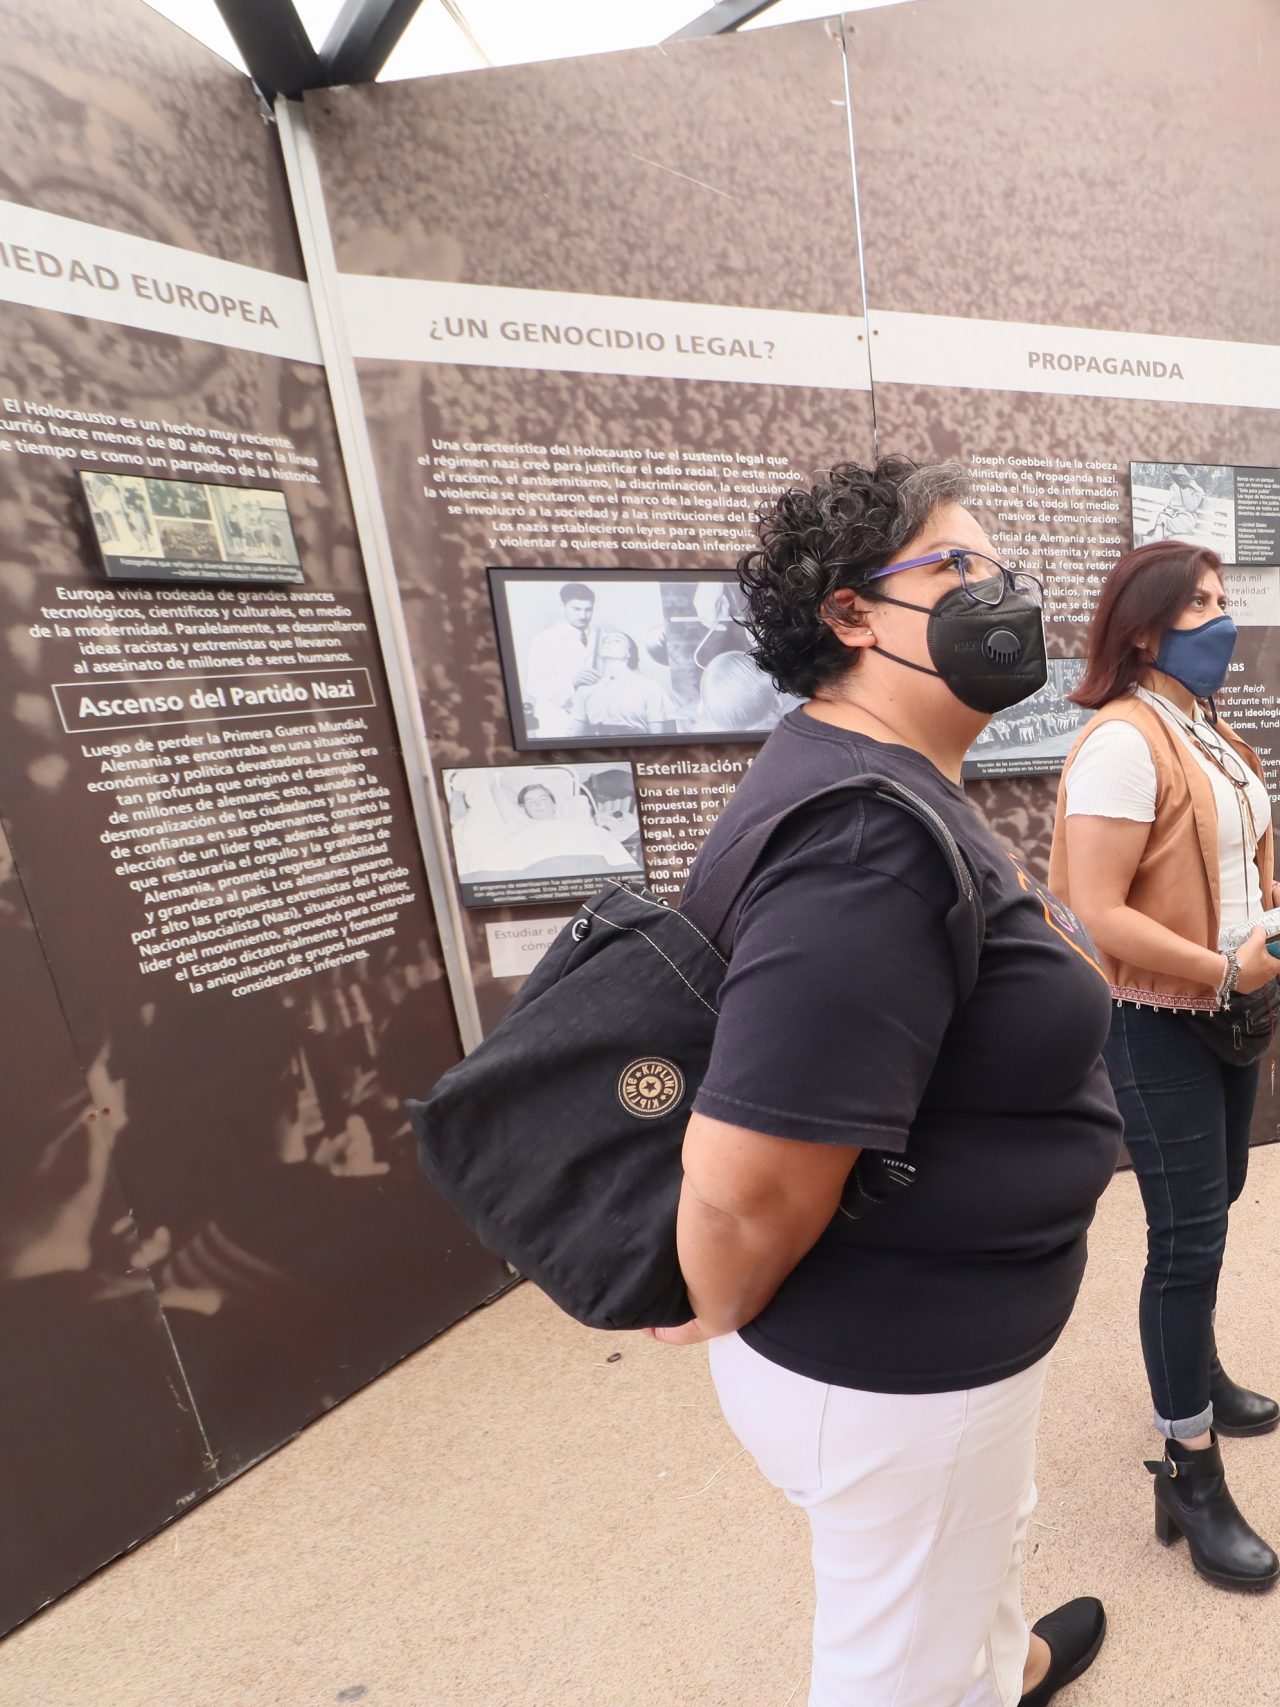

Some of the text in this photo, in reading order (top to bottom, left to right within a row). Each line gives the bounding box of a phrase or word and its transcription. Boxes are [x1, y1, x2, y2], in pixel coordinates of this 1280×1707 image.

[130, 273, 280, 329] EUROPEA
[429, 316, 776, 360] ¿UN GENOCIDIO LEGAL?
[1028, 351, 1185, 380] PROPAGANDA
[3, 399, 295, 449] El Holocausto es un hecho muy reciente.
[14, 440, 321, 484] tiempo es como un parpadeo de la historia.
[431, 438, 461, 451] Una
[549, 443, 571, 456] del
[572, 445, 643, 459] Holocausto
[644, 447, 666, 460] fue
[668, 449, 680, 461] el
[682, 452, 734, 463] sustento
[735, 451, 764, 466] legal
[766, 456, 789, 468] que
[970, 454, 1118, 471] Joseph Goebbels fue la cabeza
[1020, 469, 1033, 481] de
[1035, 470, 1094, 484] Propaganda
[1095, 475, 1118, 484] nazi.
[1249, 574, 1262, 582] mil
[73, 651, 354, 674] al asesinato de millones de seres humanos.
[78, 679, 356, 718] Ascenso del Partido Nazi
[1243, 684, 1265, 693] Reich
[1227, 697, 1260, 705] durante
[1261, 696, 1274, 704] mil
[80, 717, 369, 758] Luego de perder la Primera Guerra Mundial,
[636, 759, 743, 776] Esterilización
[642, 812, 703, 826] forzada, la
[646, 841, 698, 854] conocido,
[648, 868, 690, 880] 400 mil
[650, 883, 681, 895] física
[494, 926, 557, 939] Estudiar el
[231, 949, 370, 998] considerados inferiores.
[641, 1065, 675, 1096] KIPLING
[626, 1077, 660, 1110] KIPLING
